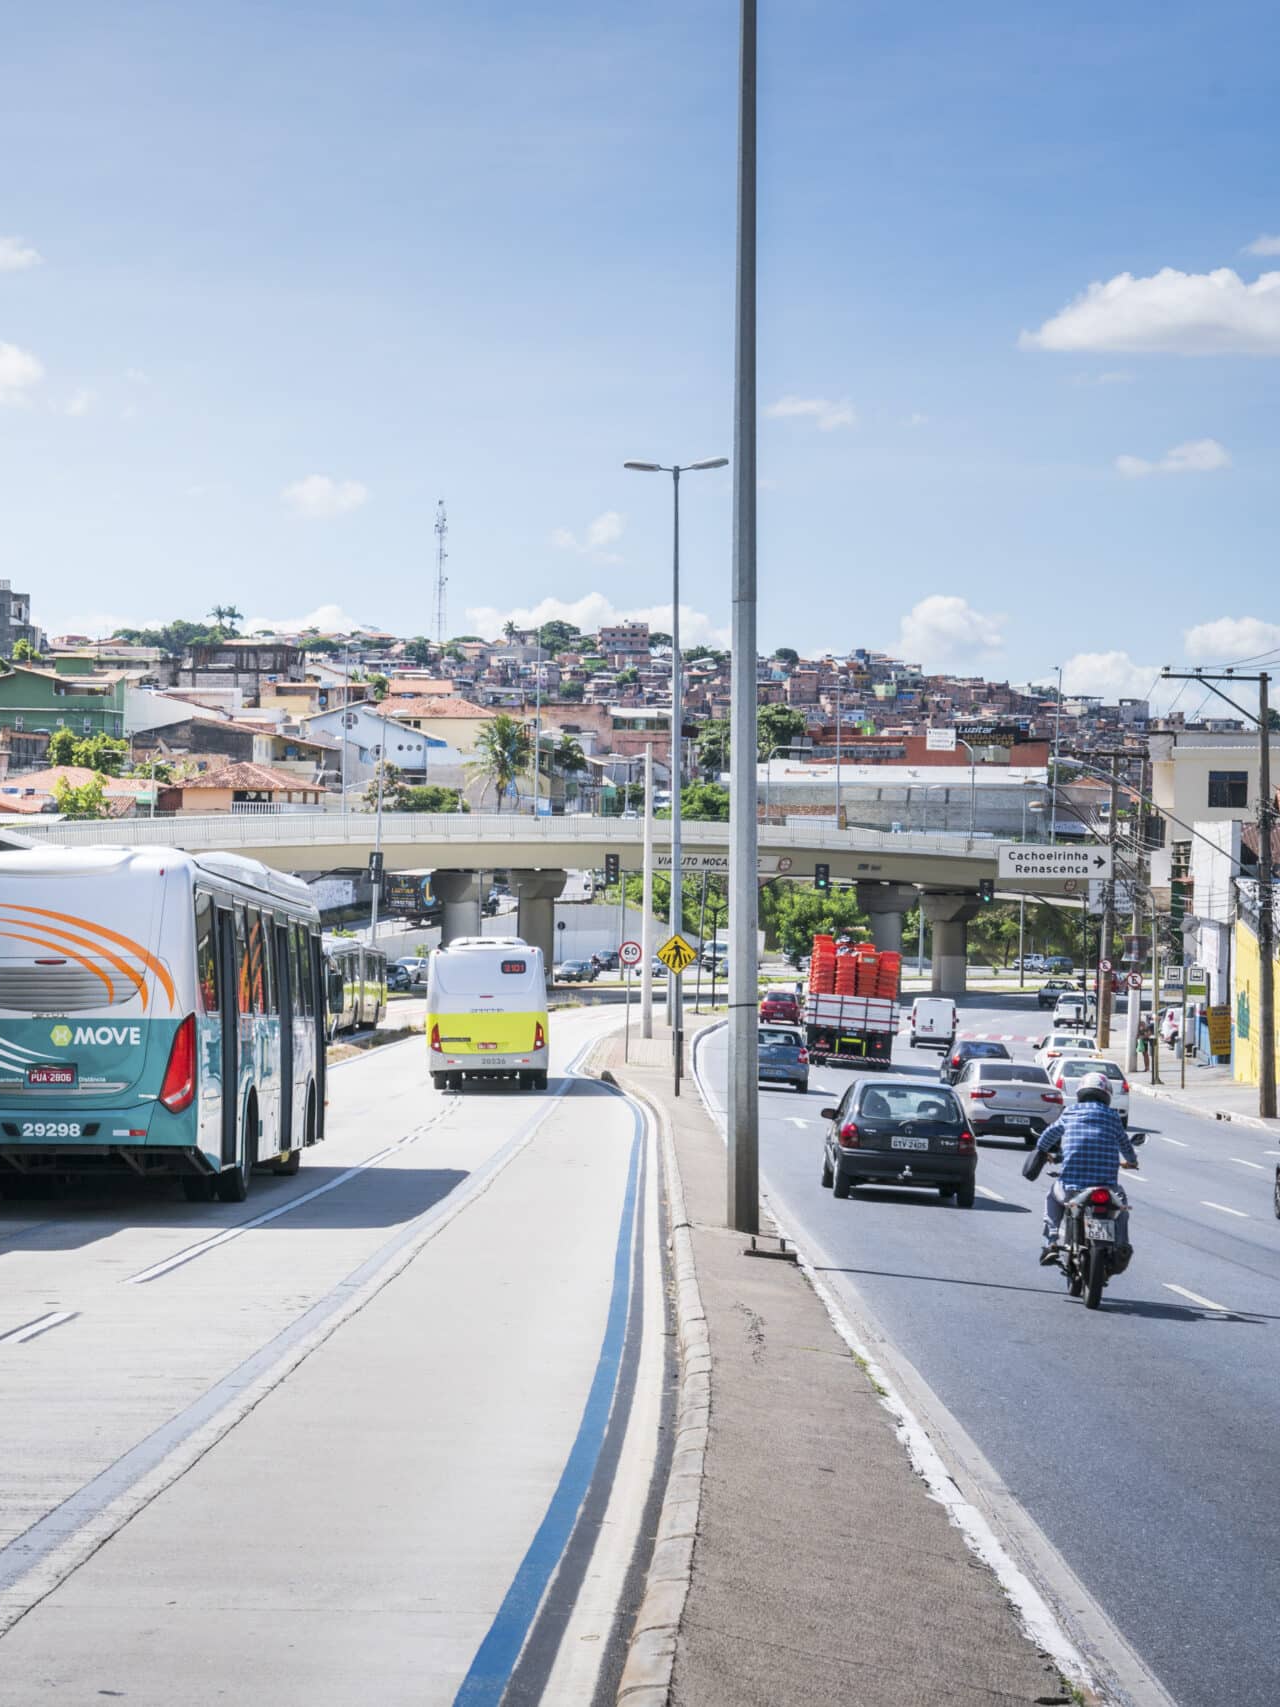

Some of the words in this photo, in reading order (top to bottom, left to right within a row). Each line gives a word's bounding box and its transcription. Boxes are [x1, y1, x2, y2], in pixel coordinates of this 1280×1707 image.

[1008, 851, 1089, 861] Cachoeirinha
[1015, 864, 1089, 875] Renascença
[624, 946, 638, 956] 60
[74, 1026, 141, 1045] MOVE
[22, 1122, 81, 1137] 29298
